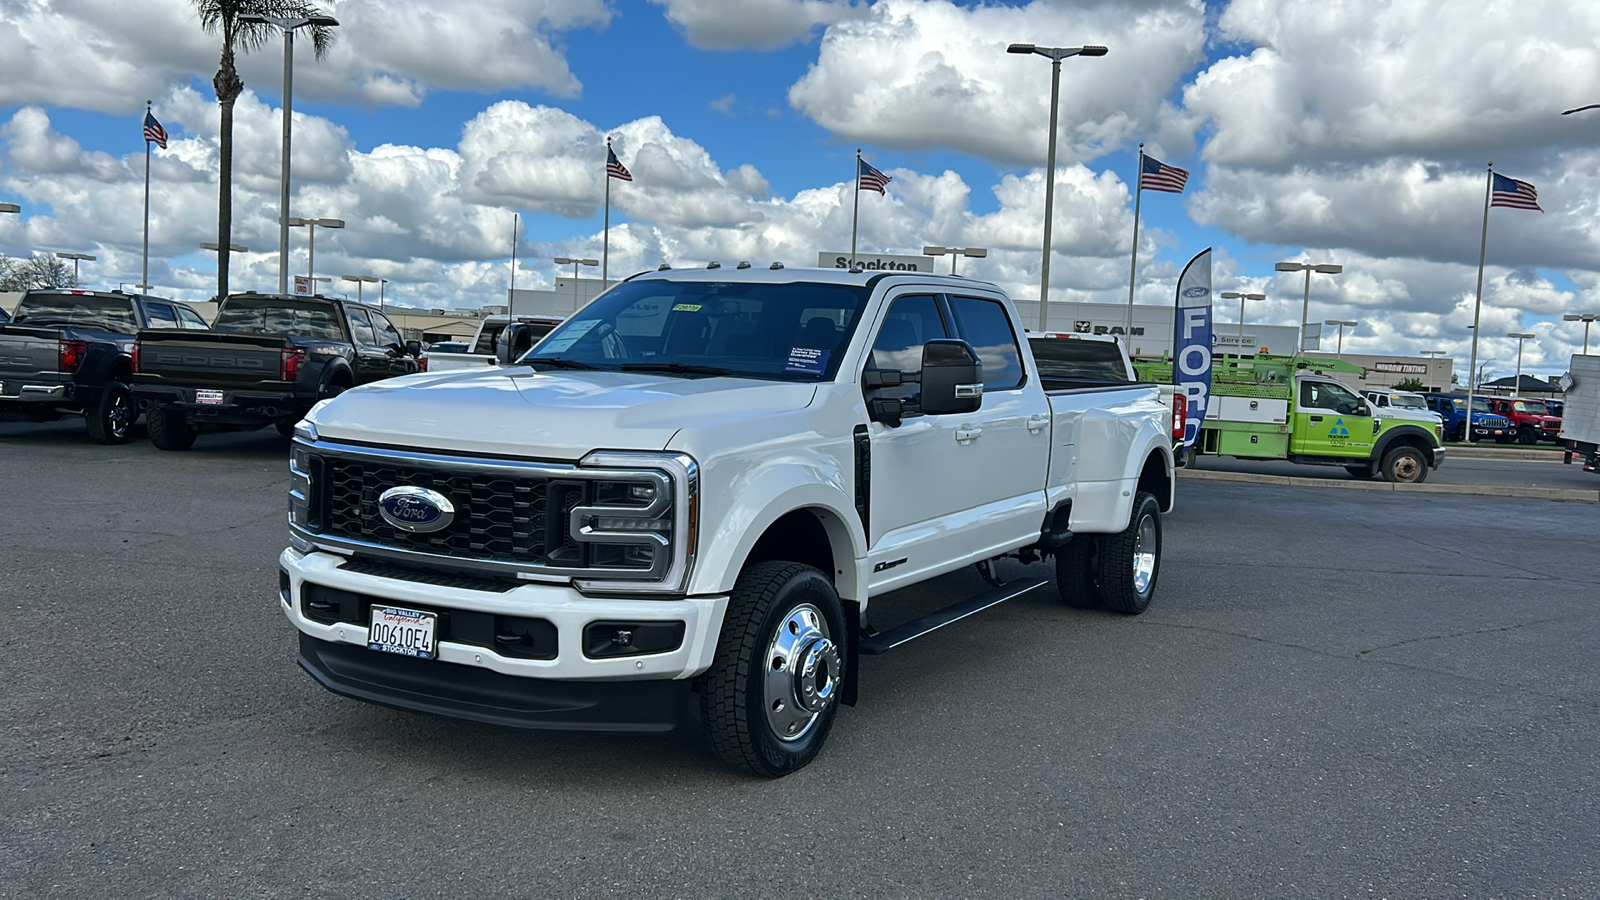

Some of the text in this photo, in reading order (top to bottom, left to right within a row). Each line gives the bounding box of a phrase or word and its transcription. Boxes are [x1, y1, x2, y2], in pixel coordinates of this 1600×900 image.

[835, 256, 918, 272] Stockton
[1186, 288, 1206, 297] Ford
[1094, 325, 1145, 336] RAM
[1220, 336, 1252, 344] Servce
[156, 353, 264, 368] FORD
[1376, 363, 1426, 374] WINDOW TINTING
[1178, 309, 1211, 447] FORD
[393, 497, 429, 520] Ford
[398, 610, 420, 619] VALLEY
[373, 622, 430, 651] 00610E4
[382, 644, 418, 657] STOCKTON
